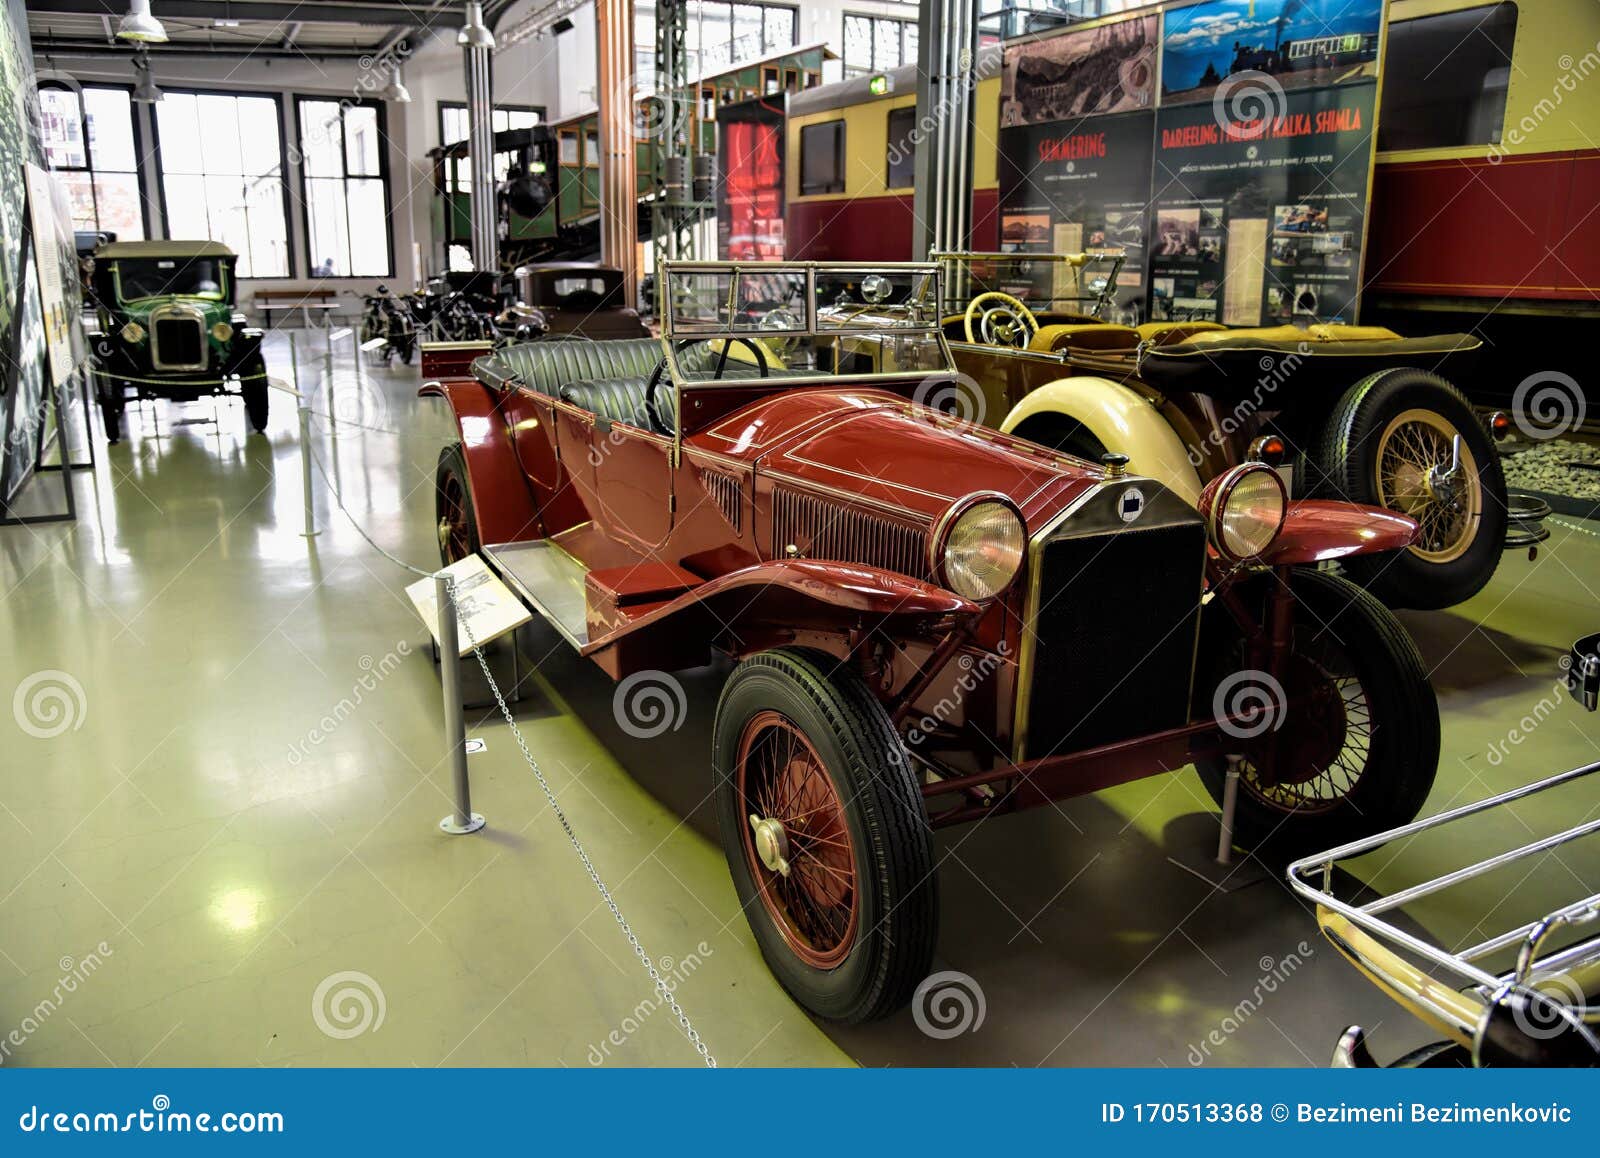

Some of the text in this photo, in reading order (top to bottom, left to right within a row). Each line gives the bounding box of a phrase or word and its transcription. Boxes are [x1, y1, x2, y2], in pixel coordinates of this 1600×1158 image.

[1162, 123, 1218, 149] DARJEELING
[1272, 112, 1311, 138] KALKA
[1315, 106, 1361, 134] SHIMLA
[1039, 132, 1106, 161] SEMMERING
